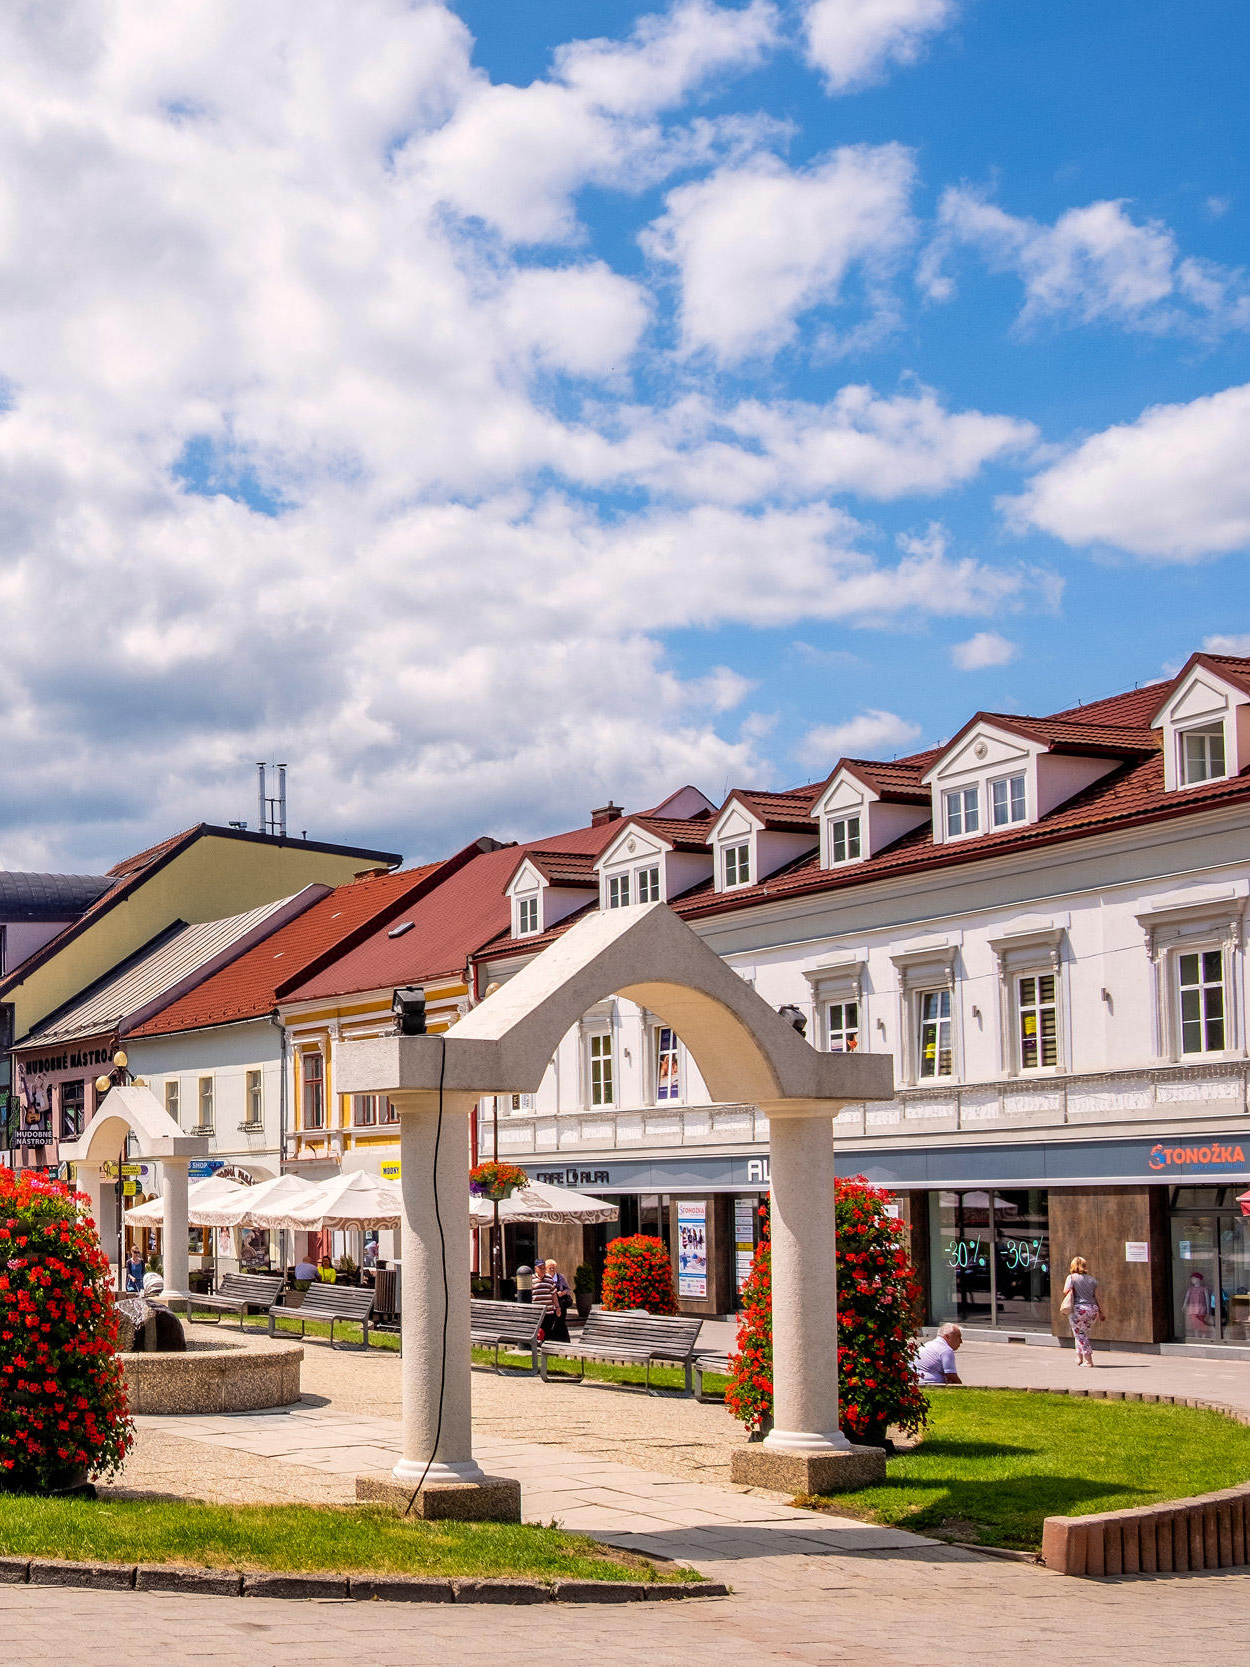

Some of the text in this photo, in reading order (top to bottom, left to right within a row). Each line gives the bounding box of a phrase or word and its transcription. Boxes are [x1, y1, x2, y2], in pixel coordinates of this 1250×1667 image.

[26, 1048, 114, 1075] HUDOBNÉ NÁSTROJ
[1149, 1143, 1245, 1170] STONOŽKA
[580, 1170, 610, 1184] ALFA
[945, 1234, 985, 1267] -30%
[1000, 1235, 1047, 1272] -30%
